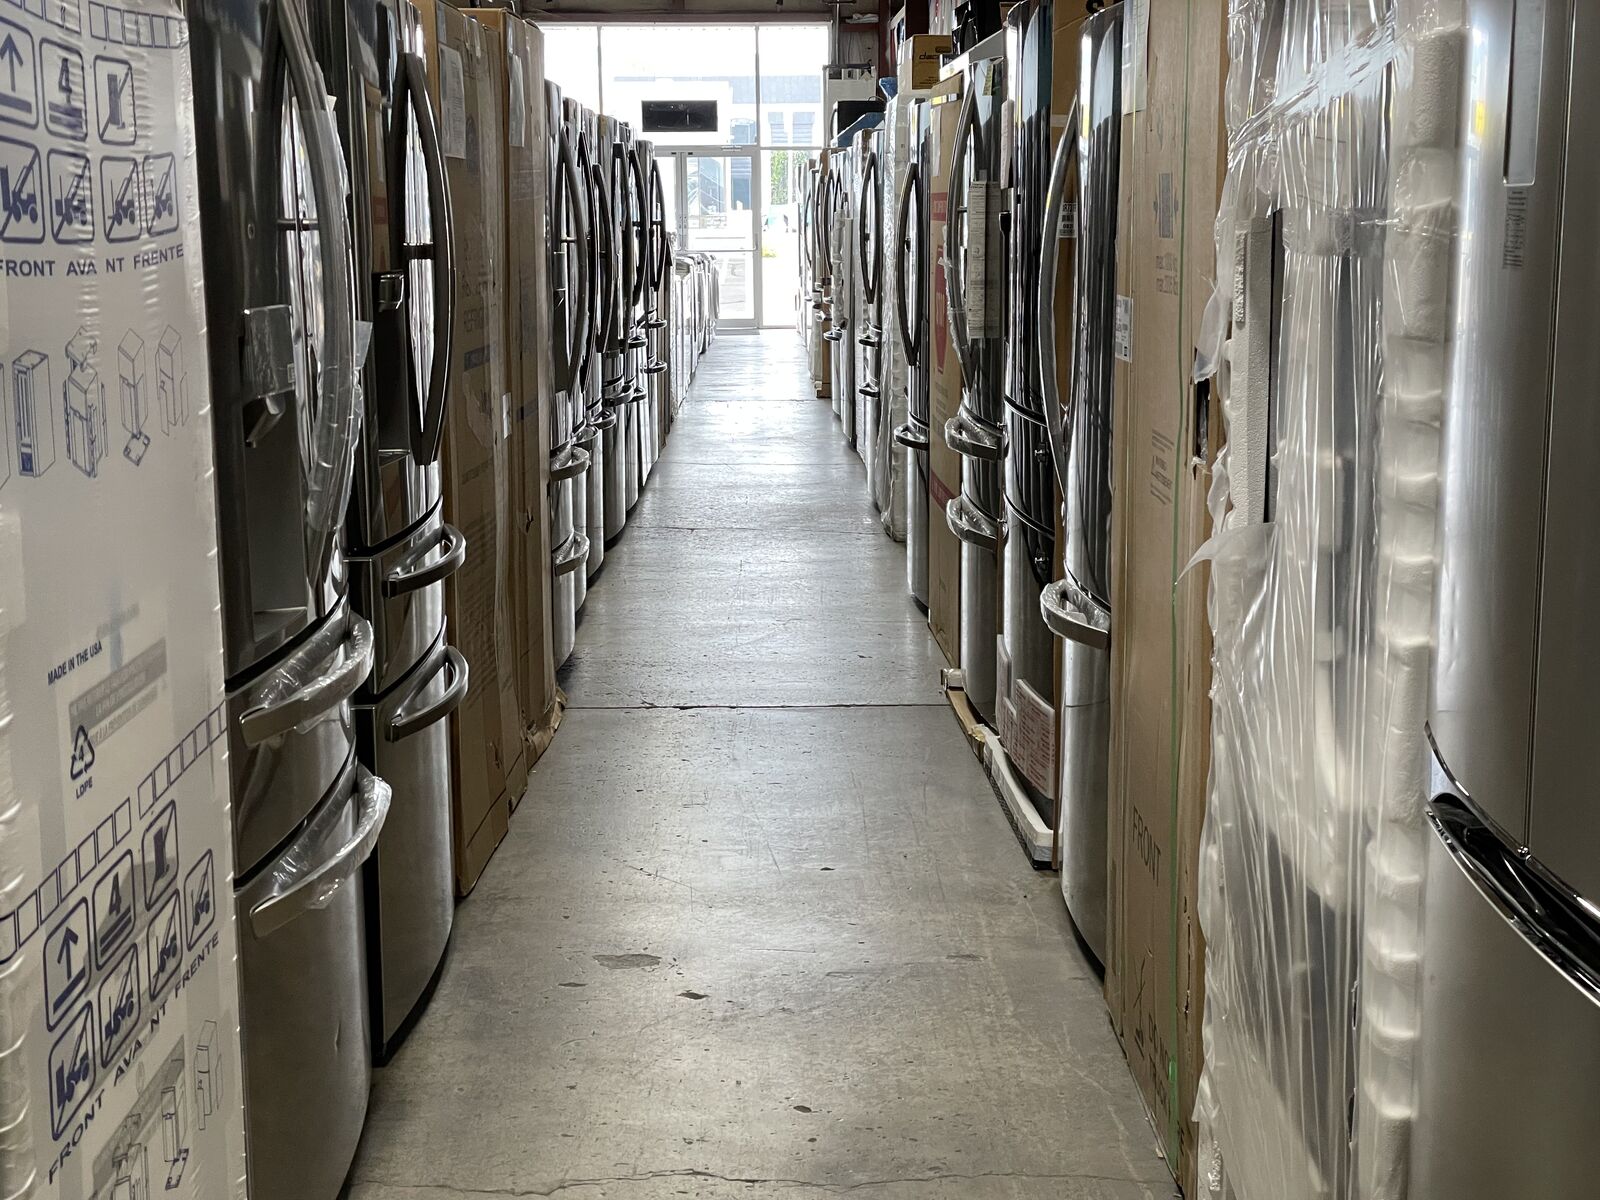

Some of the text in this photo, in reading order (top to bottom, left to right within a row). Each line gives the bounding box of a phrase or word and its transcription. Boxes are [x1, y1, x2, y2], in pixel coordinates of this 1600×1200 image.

[133, 243, 184, 270] FRENTE
[47, 640, 103, 686] MADE IN THE USA
[75, 776, 93, 800] LDPE
[1132, 804, 1161, 888] FRONT
[49, 1088, 105, 1185] FRONT
[114, 1039, 143, 1087] AVA
[174, 931, 219, 998] FRENTE
